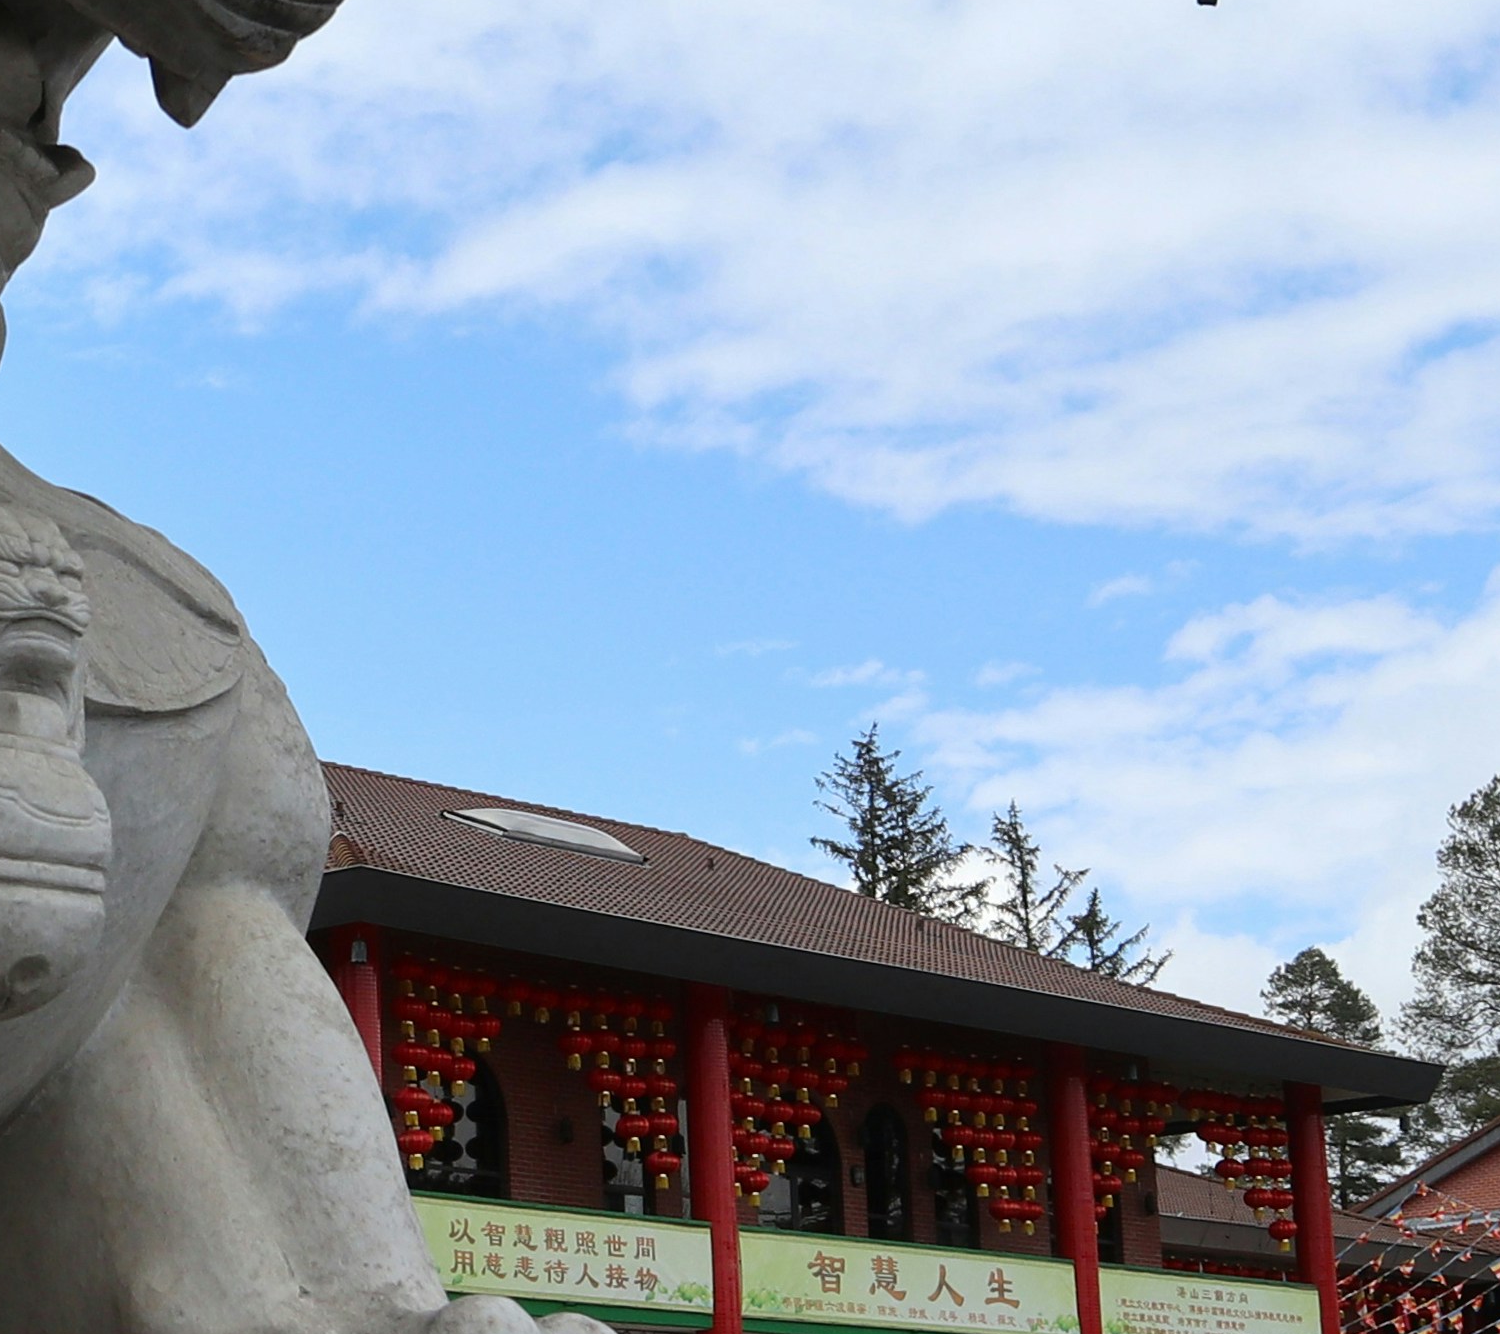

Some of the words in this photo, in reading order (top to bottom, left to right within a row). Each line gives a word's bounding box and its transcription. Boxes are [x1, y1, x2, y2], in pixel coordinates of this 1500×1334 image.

[448, 1217, 657, 1262] 以智慧觀照世間
[450, 1249, 659, 1293] 用慈悲待人接物
[807, 1250, 1021, 1310] 智慧人生
